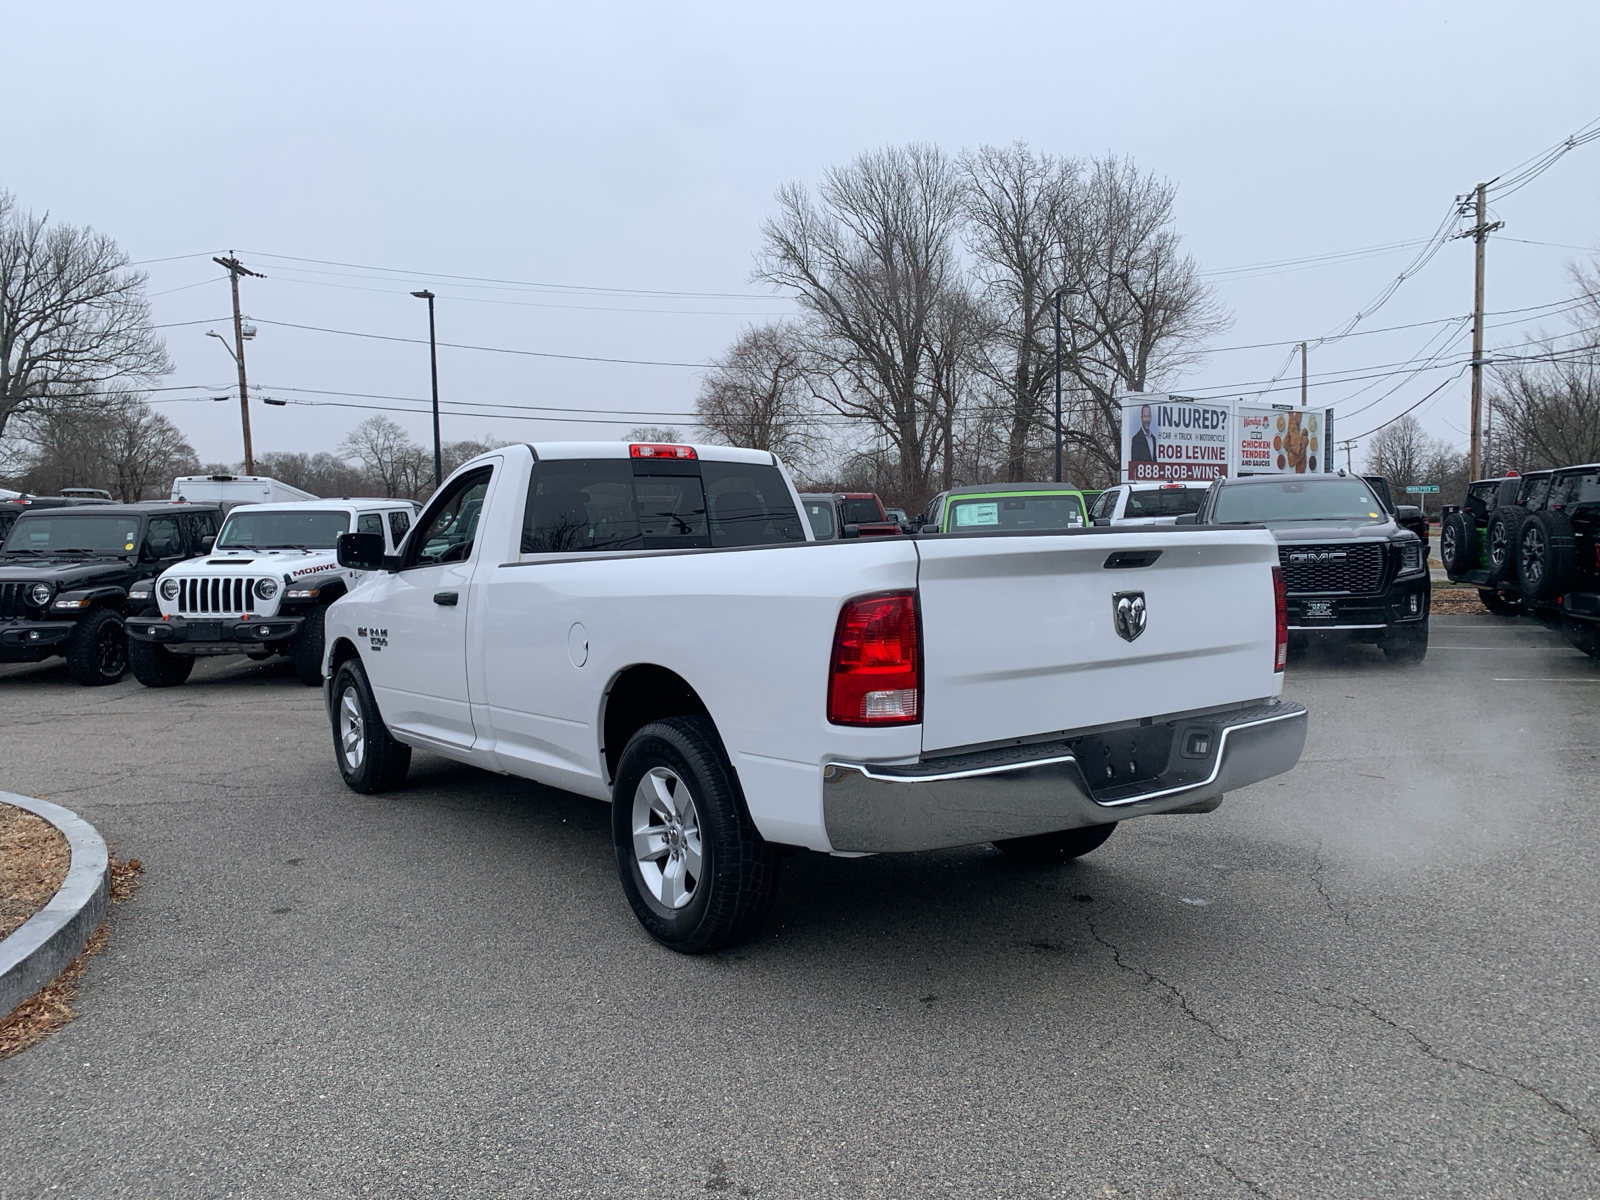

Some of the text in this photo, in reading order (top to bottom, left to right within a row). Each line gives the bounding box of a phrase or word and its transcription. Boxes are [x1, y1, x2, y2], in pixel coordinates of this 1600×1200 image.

[1157, 405, 1227, 431] INJURED?
[1243, 415, 1262, 429] Wendy's
[1162, 431, 1226, 443] CAR TRUCK MOTORCYCLE
[1241, 439, 1271, 449] CHICKEN
[1158, 444, 1226, 461] ROB LEVINE
[1241, 450, 1271, 459] TENDERS
[1241, 459, 1252, 467] AND
[1137, 464, 1220, 479] 888-ROB-WINS
[1289, 552, 1347, 564] GMC
[292, 562, 337, 577] MOJAVE
[369, 628, 388, 637] RAM
